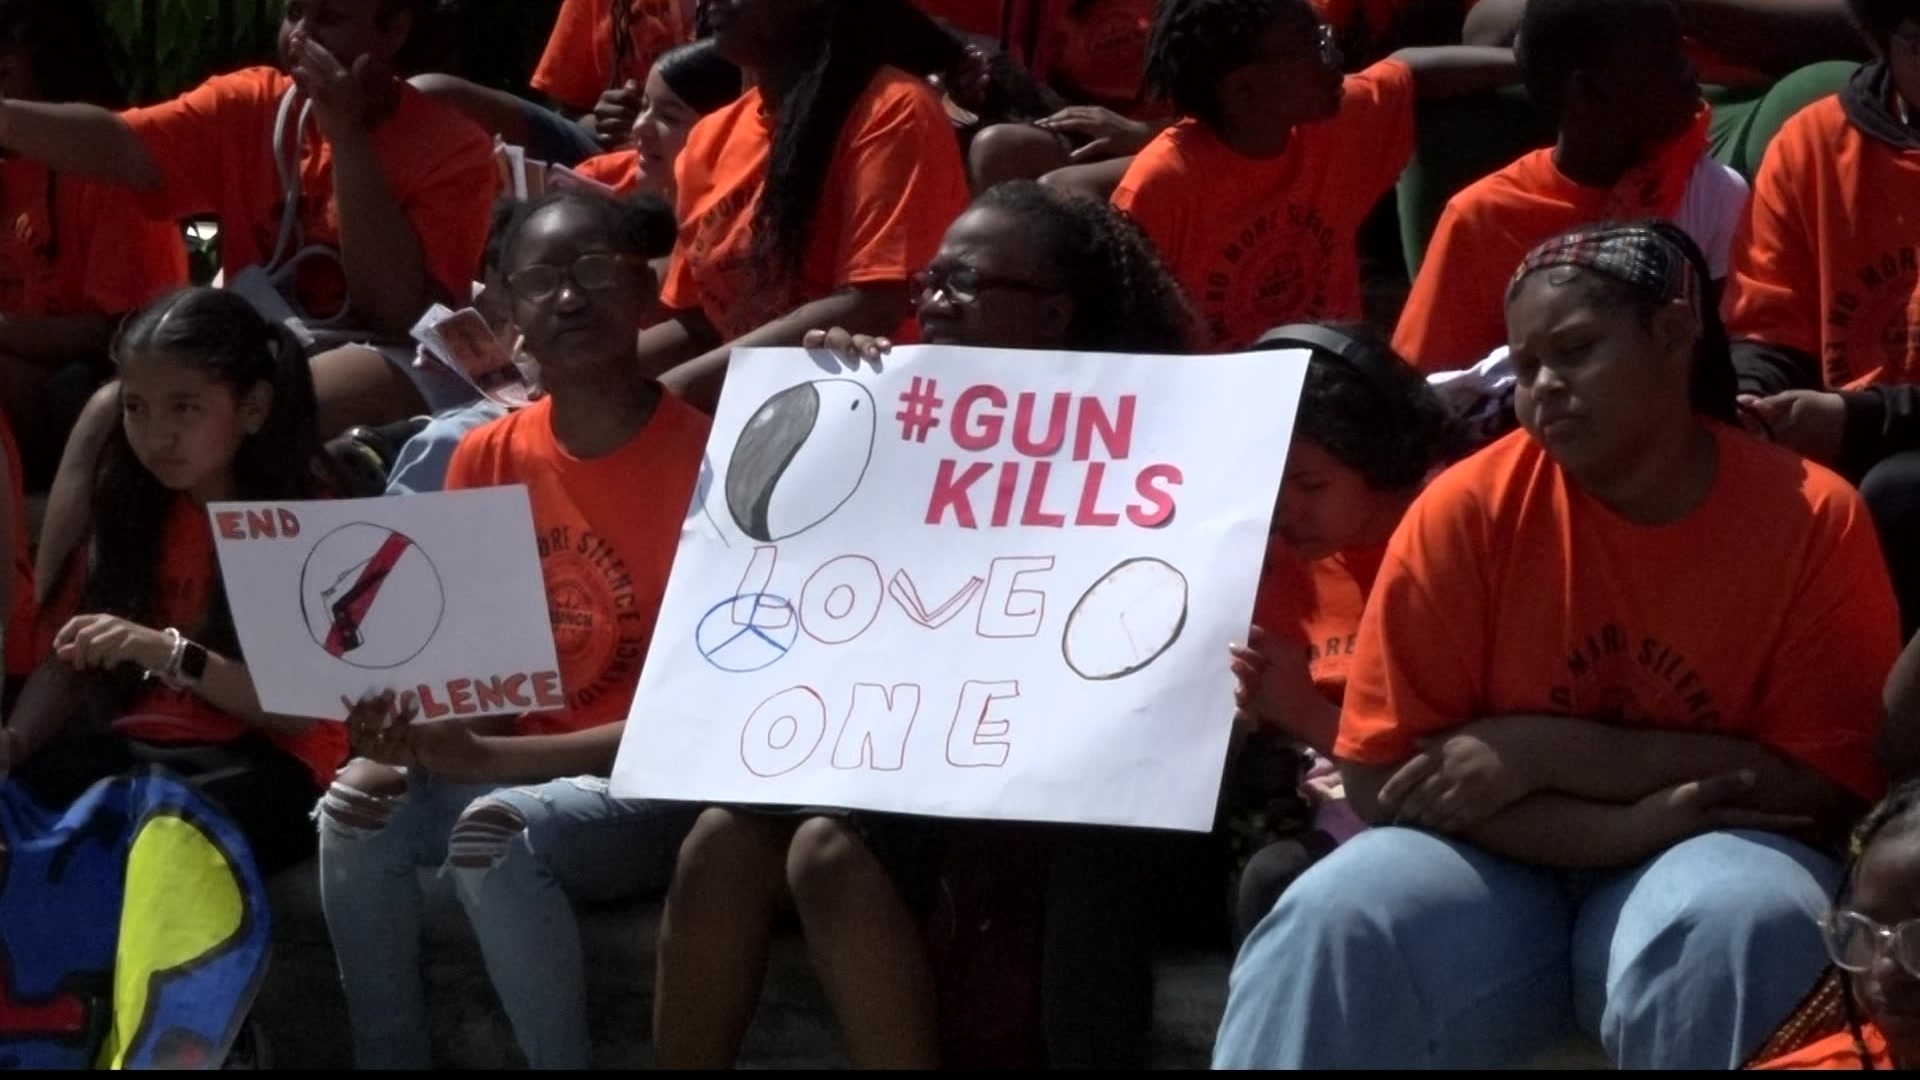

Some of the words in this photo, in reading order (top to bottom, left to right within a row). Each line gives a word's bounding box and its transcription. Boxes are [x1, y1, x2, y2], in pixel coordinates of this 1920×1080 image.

[1829, 291, 1860, 329] NO
[1856, 247, 1917, 292] MOR
[896, 376, 1137, 462] #GUN
[215, 508, 301, 541] END
[924, 459, 1184, 530] KILLS
[537, 526, 571, 558] ORE
[577, 531, 641, 624] SILENCE
[731, 545, 1056, 646] LOVE
[568, 635, 644, 713] IOLENCE
[1305, 633, 1357, 660] ORE
[1637, 637, 1721, 729] SILENC
[341, 671, 564, 721] IOLENCE
[740, 679, 1020, 778] ONE
